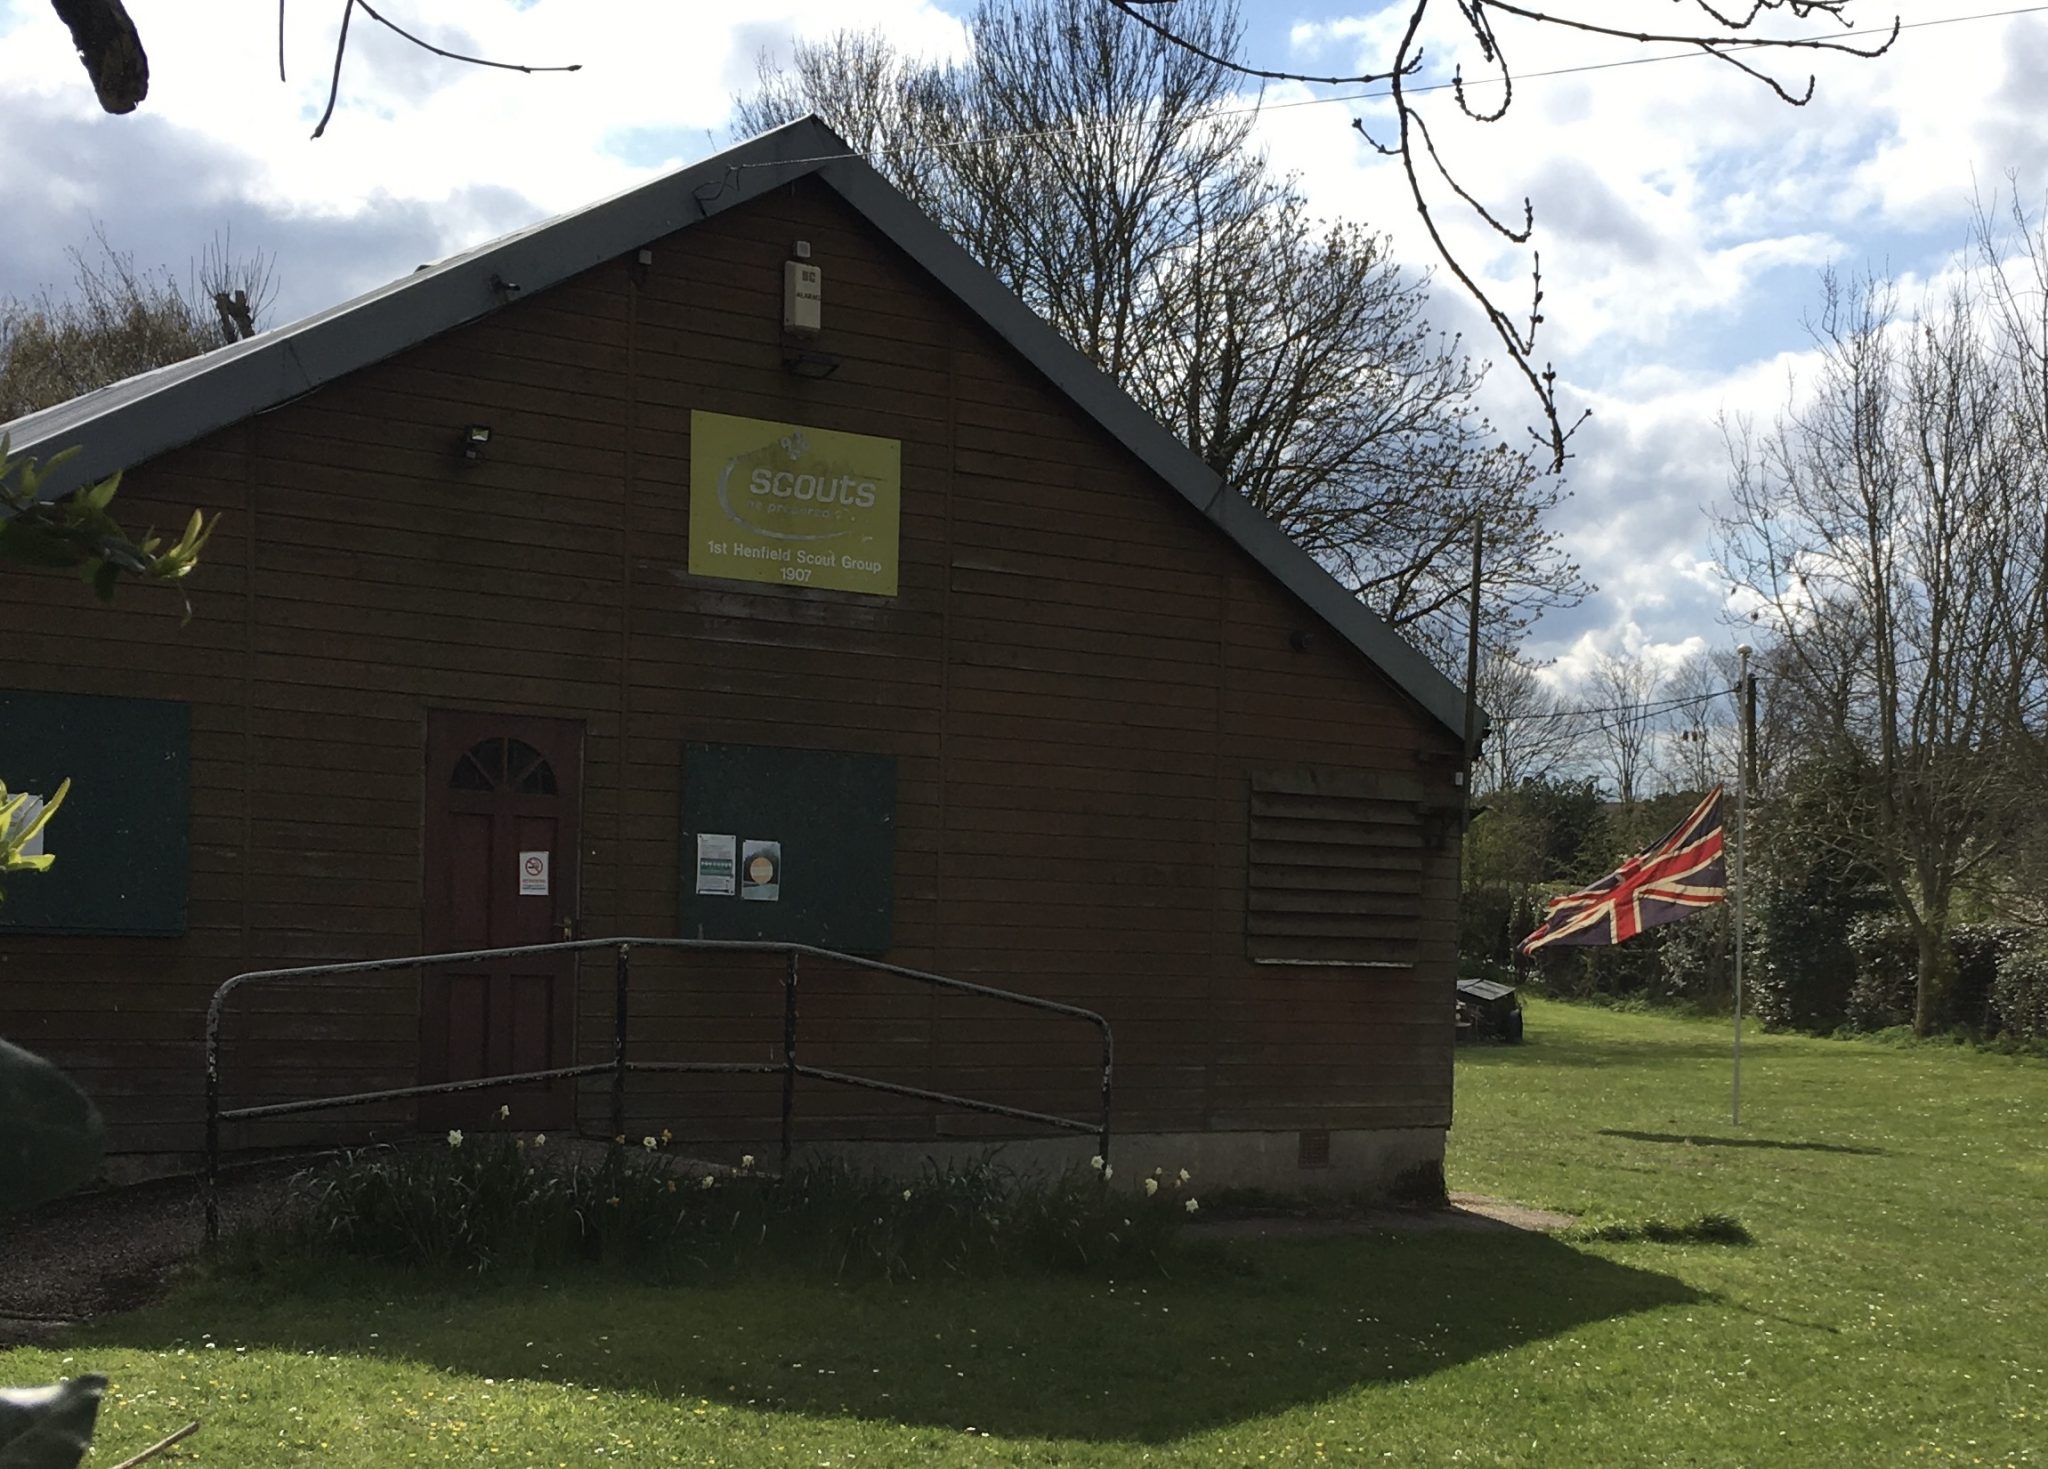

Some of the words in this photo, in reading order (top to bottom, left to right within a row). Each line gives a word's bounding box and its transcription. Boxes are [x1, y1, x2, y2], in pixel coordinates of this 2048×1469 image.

[750, 468, 877, 508] scouts
[708, 540, 728, 554] 1st
[733, 543, 791, 562] Henfield
[796, 551, 836, 567] Scout
[841, 555, 882, 574] Group
[780, 567, 812, 582] 1907
